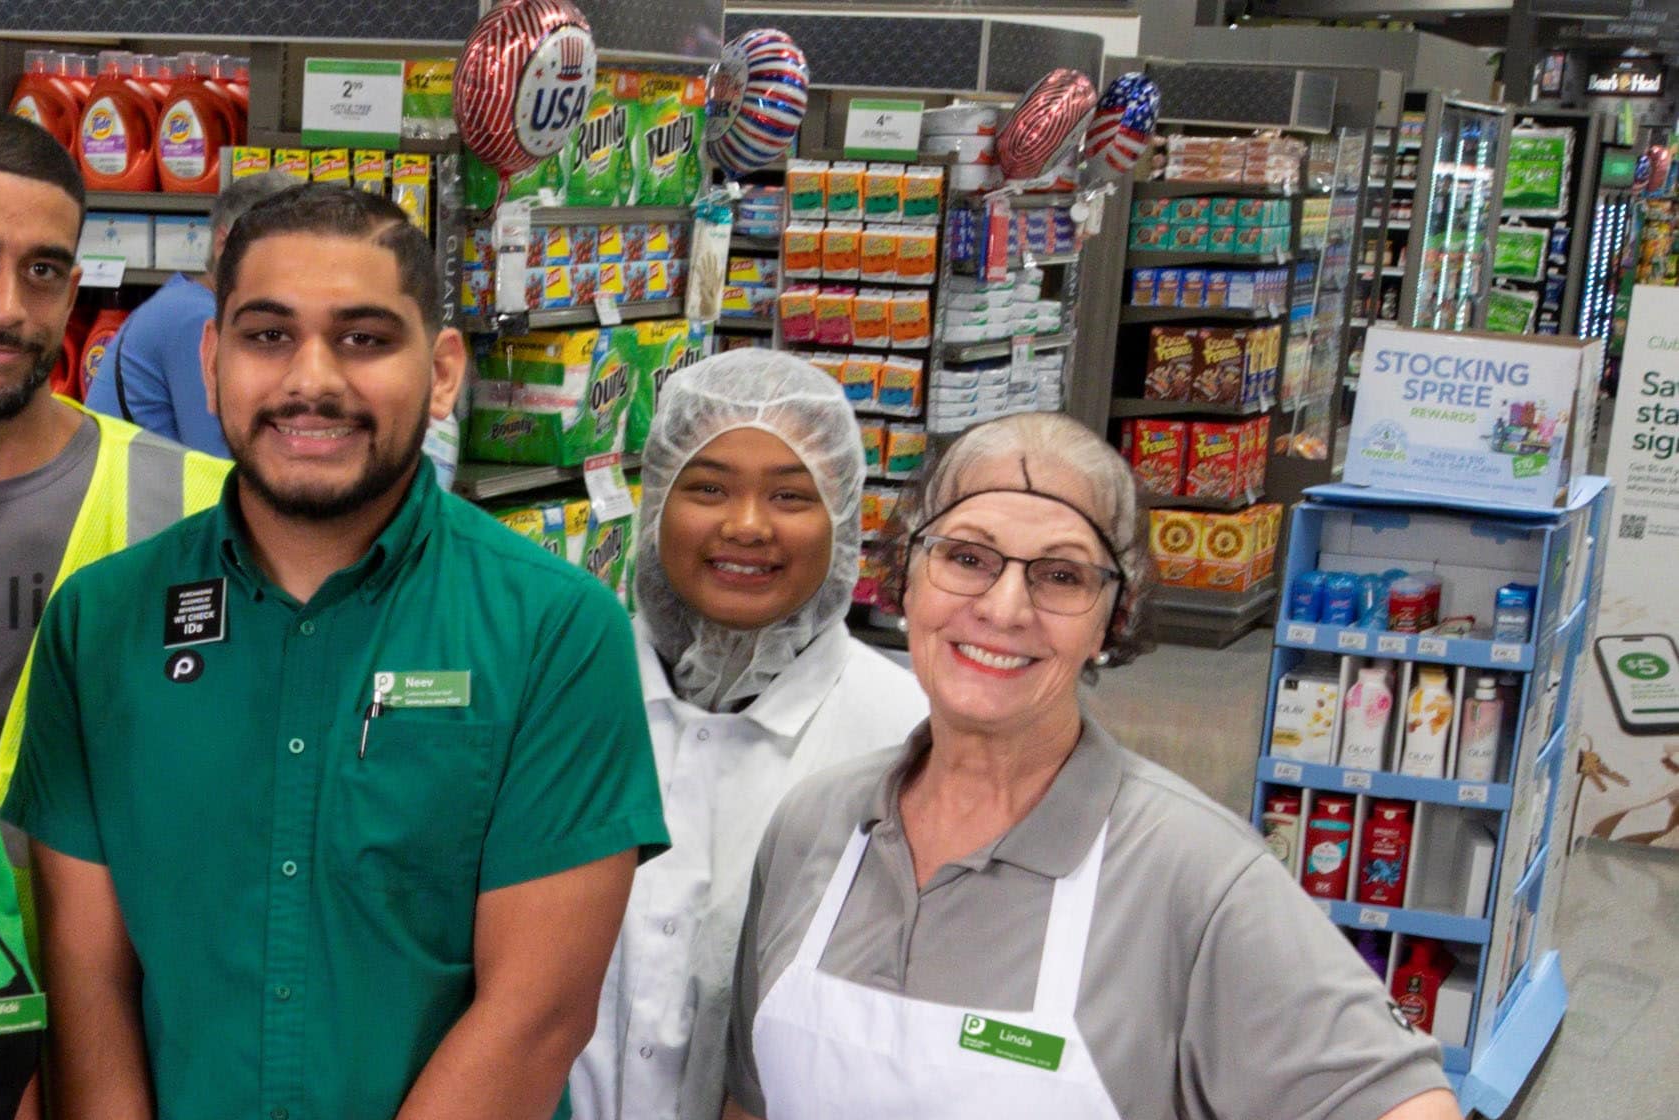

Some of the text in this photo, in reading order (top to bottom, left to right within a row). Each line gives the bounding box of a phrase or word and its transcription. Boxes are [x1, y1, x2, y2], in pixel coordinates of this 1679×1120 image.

[530, 85, 587, 132] USA
[92, 116, 111, 129] Tide
[170, 119, 190, 133] Tide
[1375, 350, 1530, 386] STOCKING
[1403, 379, 1493, 408] SPREE
[1409, 406, 1478, 424] REWARDS
[173, 610, 216, 624] WE CHECK
[183, 623, 204, 635] IDs
[1626, 658, 1659, 675] $5
[405, 677, 434, 688] Neev
[999, 1028, 1033, 1048] Linda
